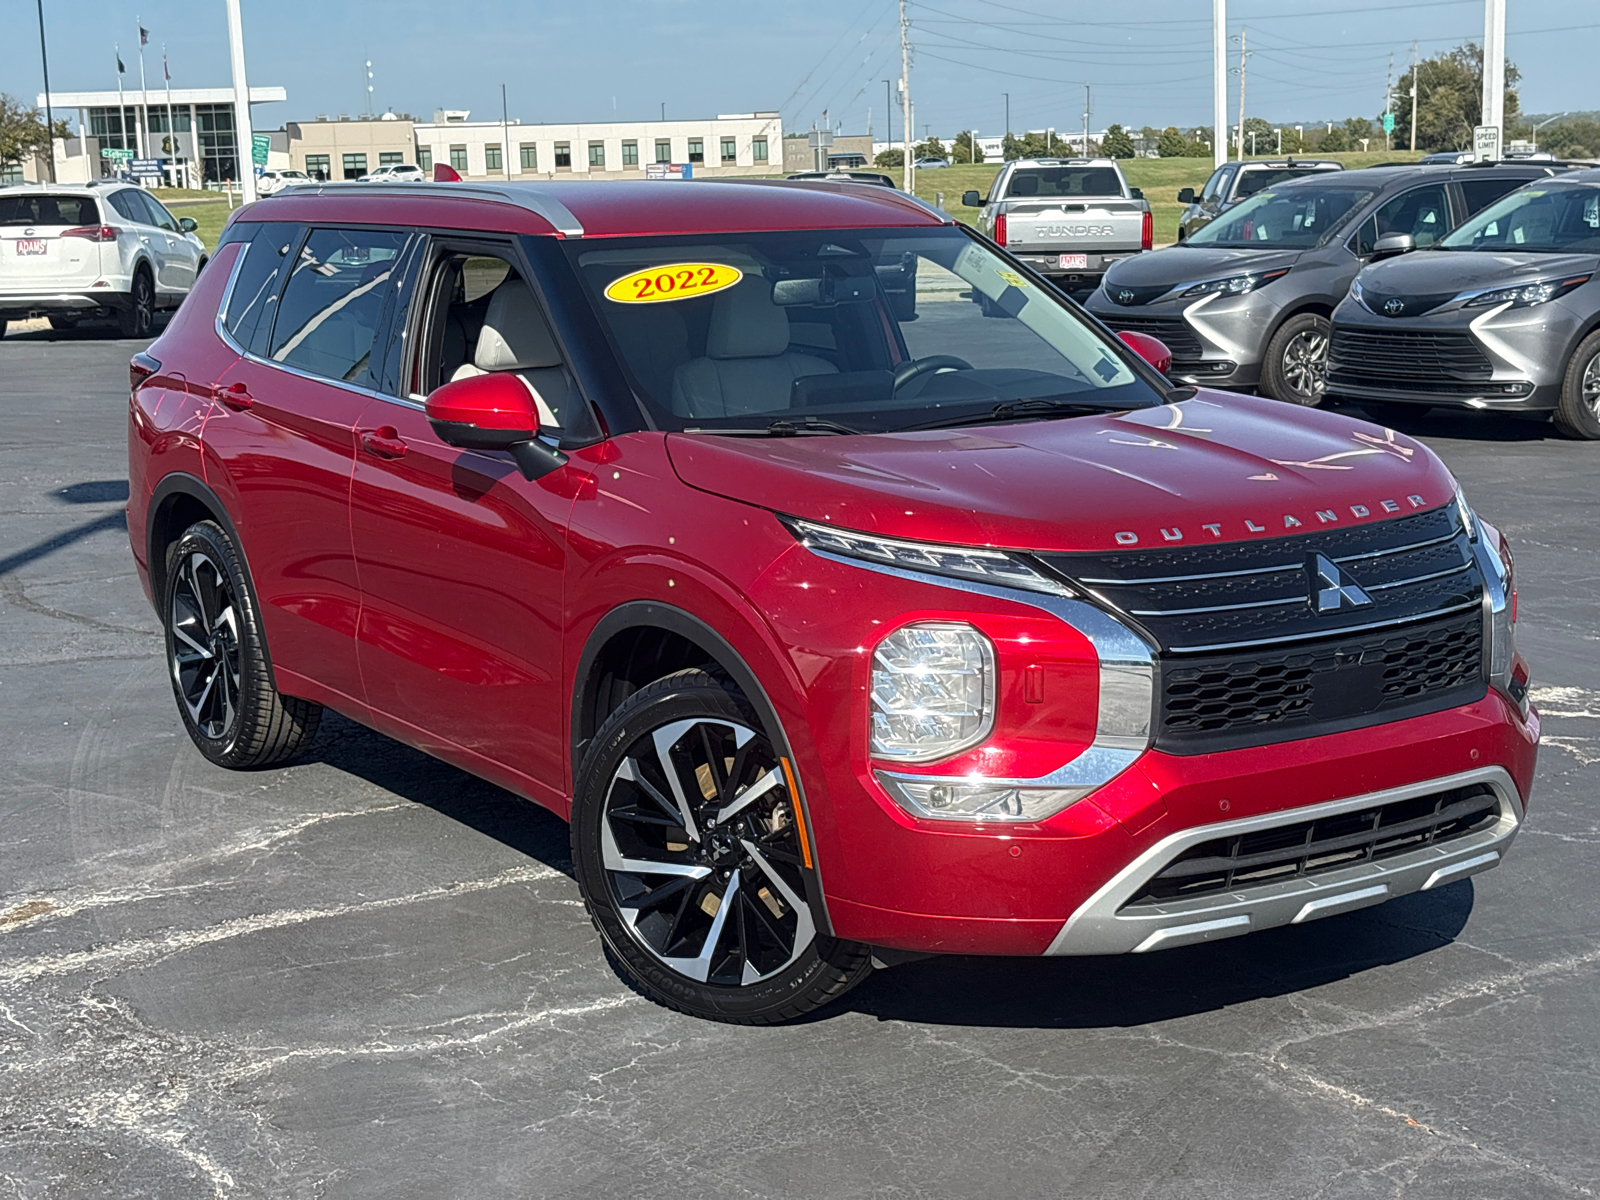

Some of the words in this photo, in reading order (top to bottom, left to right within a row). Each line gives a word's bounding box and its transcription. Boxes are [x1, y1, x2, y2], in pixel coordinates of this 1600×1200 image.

[1034, 225, 1116, 237] TUNDRA
[18, 240, 46, 253] ADAMS
[1061, 255, 1085, 267] ADAMS
[633, 267, 719, 299] 2022
[1114, 493, 1428, 546] OUTLANDER
[608, 924, 696, 999] GOODYEAR
